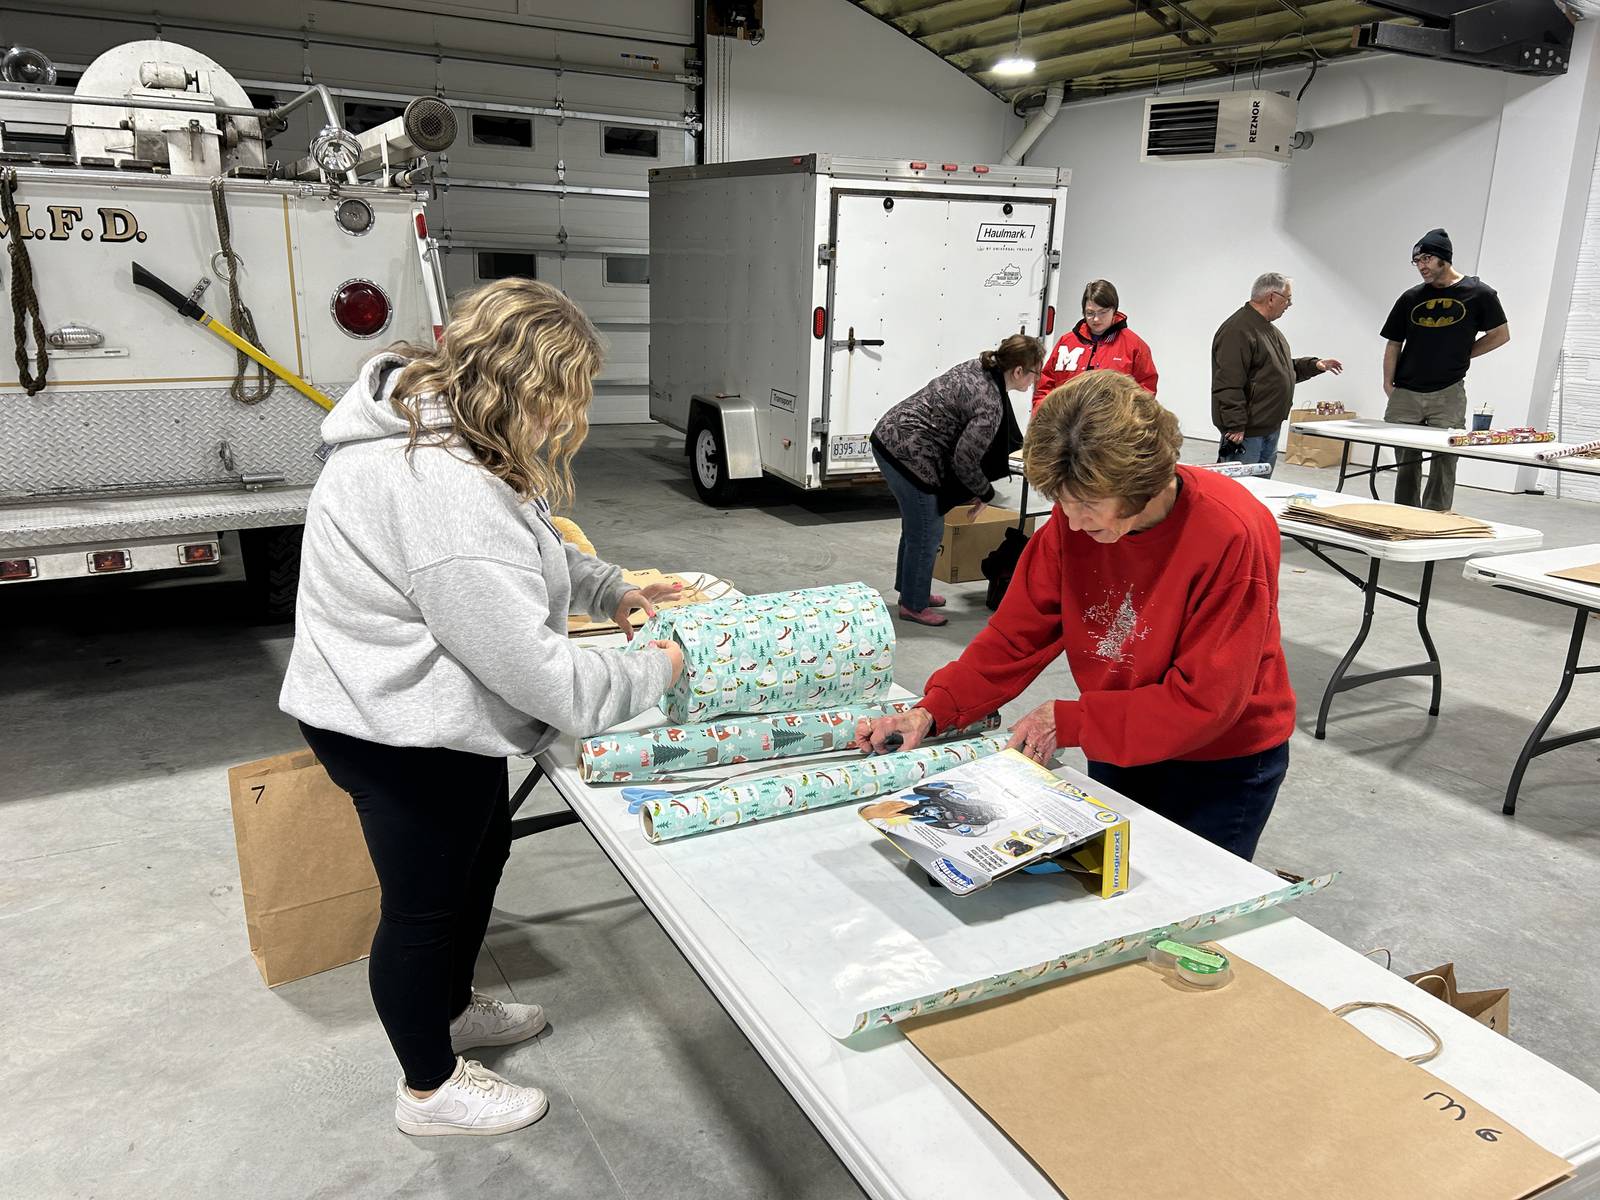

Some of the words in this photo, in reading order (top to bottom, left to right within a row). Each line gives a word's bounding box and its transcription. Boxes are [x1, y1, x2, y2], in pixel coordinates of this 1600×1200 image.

[1248, 100, 1261, 143] REZNOR
[983, 227, 1026, 239] Haulmark
[1054, 345, 1085, 372] M
[833, 442, 853, 456] 8395
[250, 784, 266, 805] 7
[1113, 831, 1121, 888] imaginext
